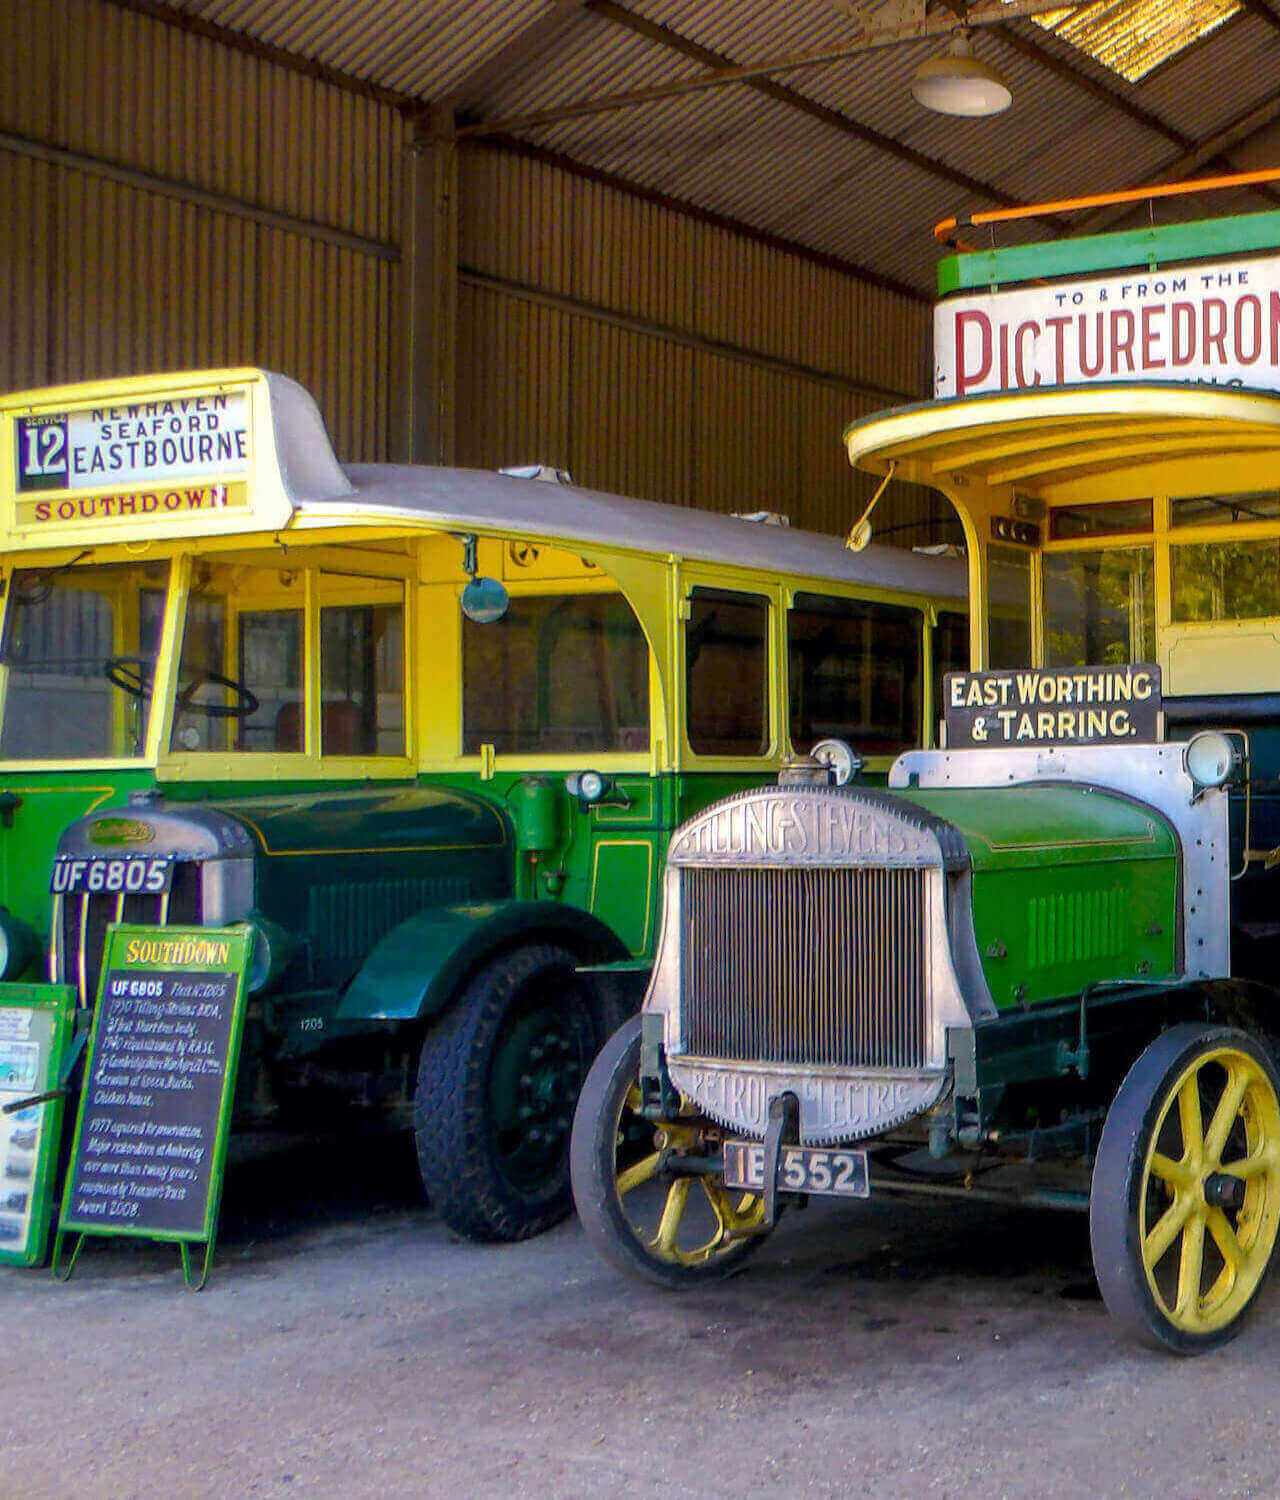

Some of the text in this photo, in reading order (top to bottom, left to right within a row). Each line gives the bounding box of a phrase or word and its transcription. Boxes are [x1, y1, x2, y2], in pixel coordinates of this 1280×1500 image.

[1055, 290, 1085, 308] TO
[1121, 276, 1188, 299] FROM
[1201, 269, 1250, 289] THE
[91, 394, 228, 423] NEWHAVEN
[100, 413, 219, 441] SEAFORD
[25, 426, 66, 475] 12
[73, 428, 248, 474] EASTBOURNE
[35, 484, 229, 522] SOUTHDOWN
[951, 672, 1152, 708] EAST WORTHING
[971, 716, 988, 741] &
[125, 939, 231, 965] SOUTHDOWN
[784, 1151, 855, 1192] 552
